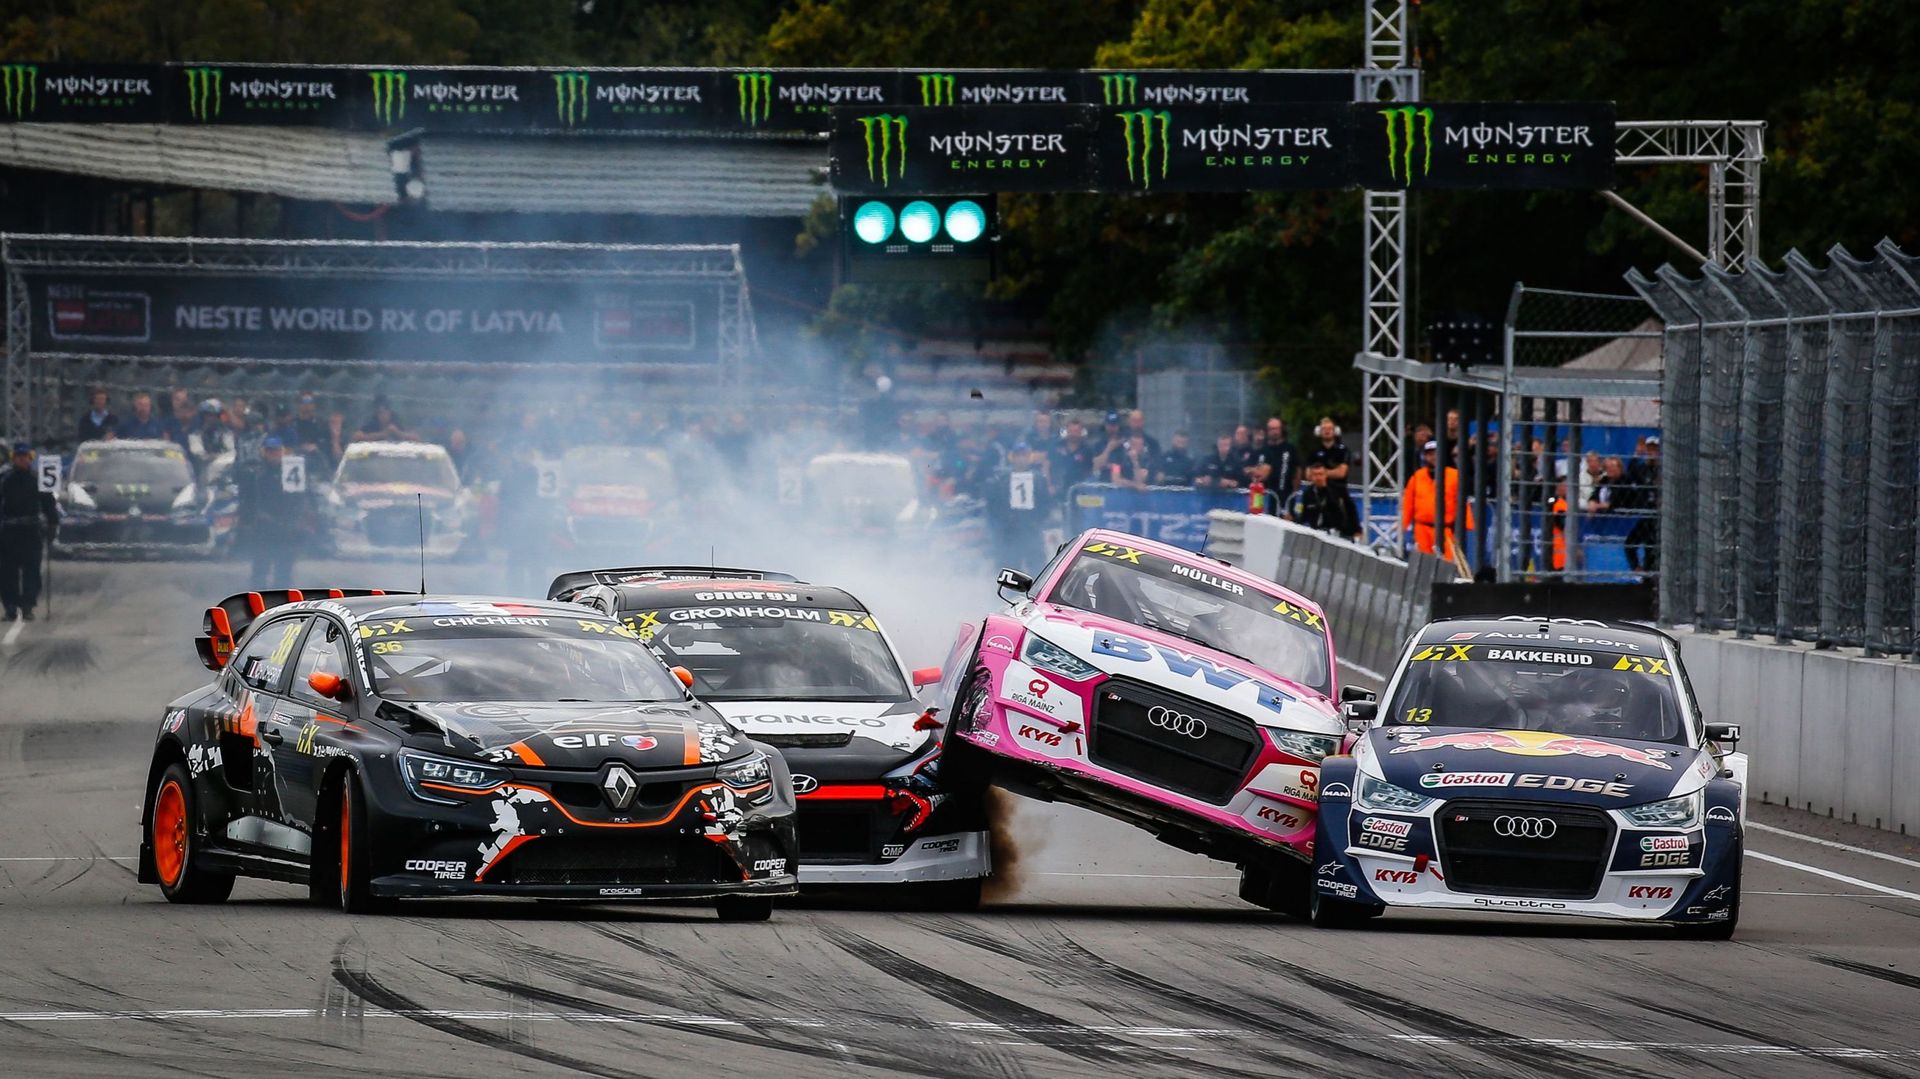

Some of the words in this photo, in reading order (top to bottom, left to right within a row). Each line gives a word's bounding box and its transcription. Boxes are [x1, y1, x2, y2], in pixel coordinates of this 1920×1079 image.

[45, 76, 151, 96] MONSTER
[230, 78, 336, 99] MONSTER
[413, 82, 519, 102] MONSTER
[596, 83, 701, 103] MONSTER
[778, 83, 883, 102] MONSTER
[961, 84, 1066, 103] MONSTER
[1144, 84, 1250, 104] MONSTER
[1182, 123, 1333, 152] MONSTER
[1444, 121, 1594, 149] MONSTER
[930, 131, 1066, 156] MONSTER
[951, 160, 1047, 170] ENERGY
[1206, 155, 1310, 166] ENERGY
[1467, 153, 1573, 164] ENERGY
[175, 306, 262, 332] NESTE
[269, 307, 373, 333] WORLD
[380, 310, 416, 333] RX
[424, 310, 462, 333] OF
[470, 311, 564, 333] LATVIA
[43, 466, 57, 488] 5
[286, 466, 300, 486] 4
[1015, 483, 1027, 503] 1
[1171, 564, 1245, 596] MÜLLER
[695, 591, 797, 601] energy
[432, 616, 550, 627] CHICHERIT
[669, 606, 821, 622] GRONHOLM
[371, 641, 404, 654] 36
[989, 641, 1013, 652] MAN
[1484, 631, 1550, 641] Audi
[1558, 634, 1640, 651] Sport
[1487, 649, 1593, 666] BAKKERUD
[1091, 630, 1298, 715] BWT
[1011, 691, 1030, 706] RIGA
[1029, 698, 1056, 715] MAINZ
[1405, 707, 1434, 723] 13
[552, 734, 617, 749] elf
[1017, 724, 1063, 748] KYB
[1283, 785, 1301, 797] RIGA
[1323, 789, 1348, 797] MAN
[1441, 772, 1507, 785] Castrol
[1513, 773, 1637, 800] EDGE
[1257, 806, 1298, 828] KYB
[1372, 819, 1408, 835] Castrol
[921, 838, 960, 850] COOPER
[1358, 832, 1410, 851] EDGE
[1653, 838, 1687, 850] Castrol
[882, 847, 903, 856] OMP
[1640, 852, 1690, 867] EDGE
[405, 859, 467, 871] COOPER
[754, 858, 786, 871] COOPER
[433, 871, 466, 880] TIRES
[769, 869, 785, 877] TIRES
[1375, 868, 1418, 884] KYB
[1317, 879, 1358, 893] COOPER
[1335, 889, 1356, 899] TIRES
[1628, 885, 1673, 899] KYB
[1474, 898, 1566, 909] quattro
